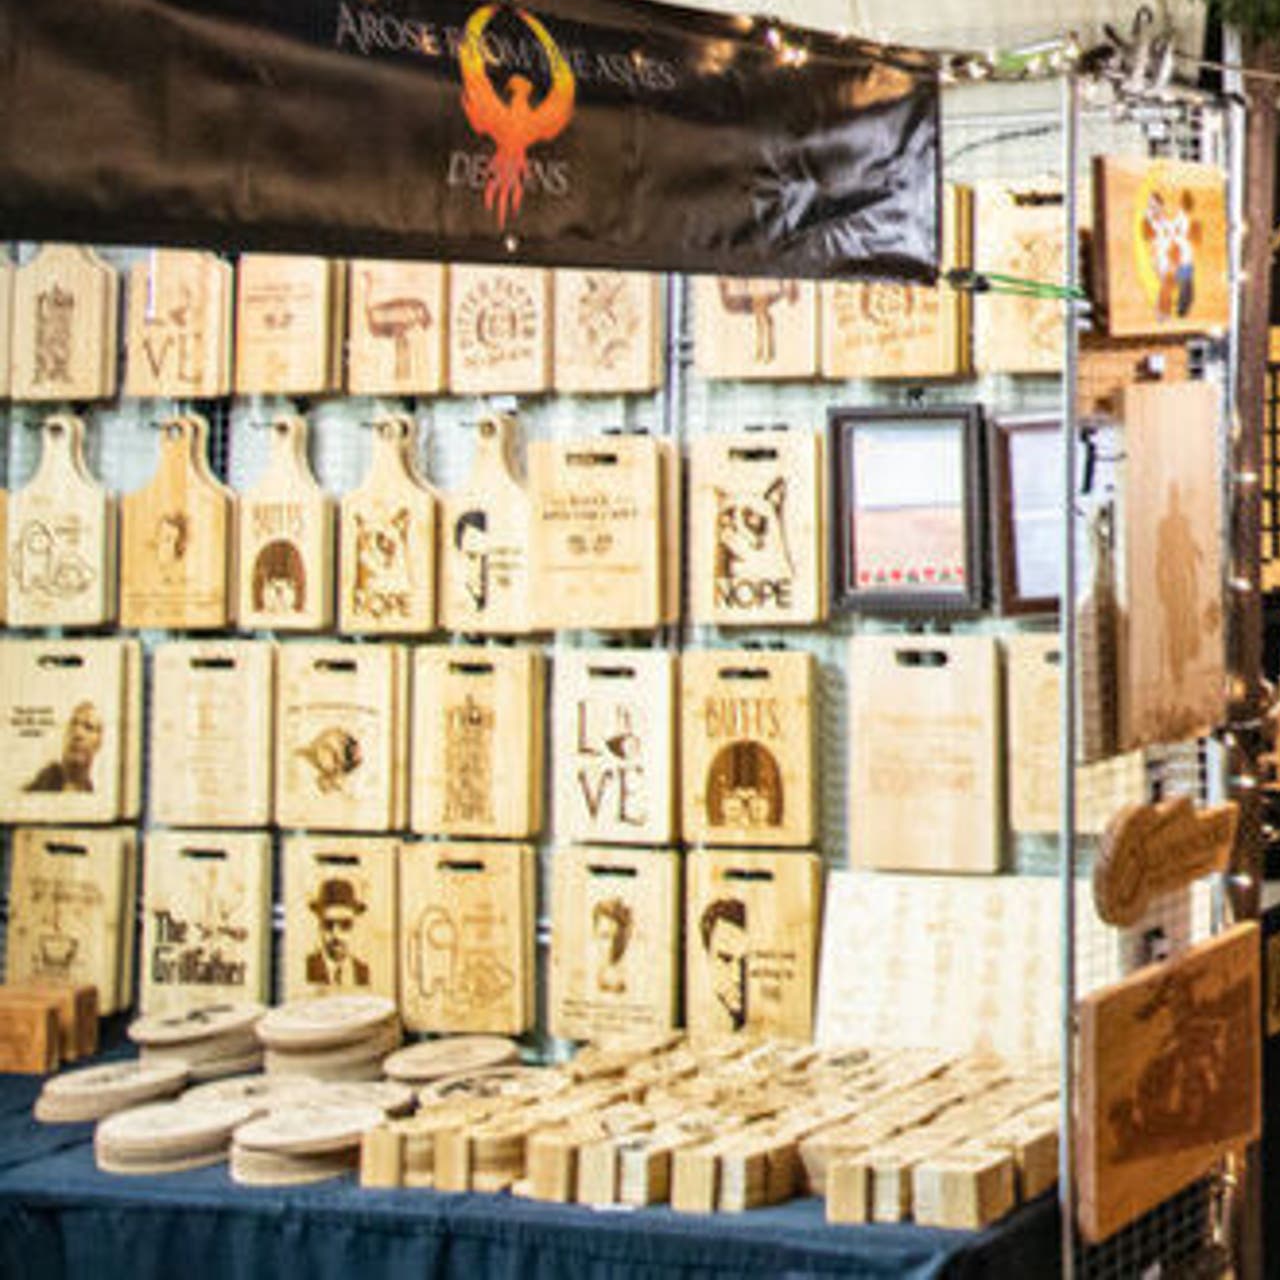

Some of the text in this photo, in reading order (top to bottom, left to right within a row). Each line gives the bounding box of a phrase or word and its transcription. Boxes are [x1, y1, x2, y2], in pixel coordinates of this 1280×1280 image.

[336, 0, 437, 55] AROSE
[714, 579, 790, 608] NOPE
[154, 909, 188, 943] The
[152, 944, 245, 985] Grillfather
